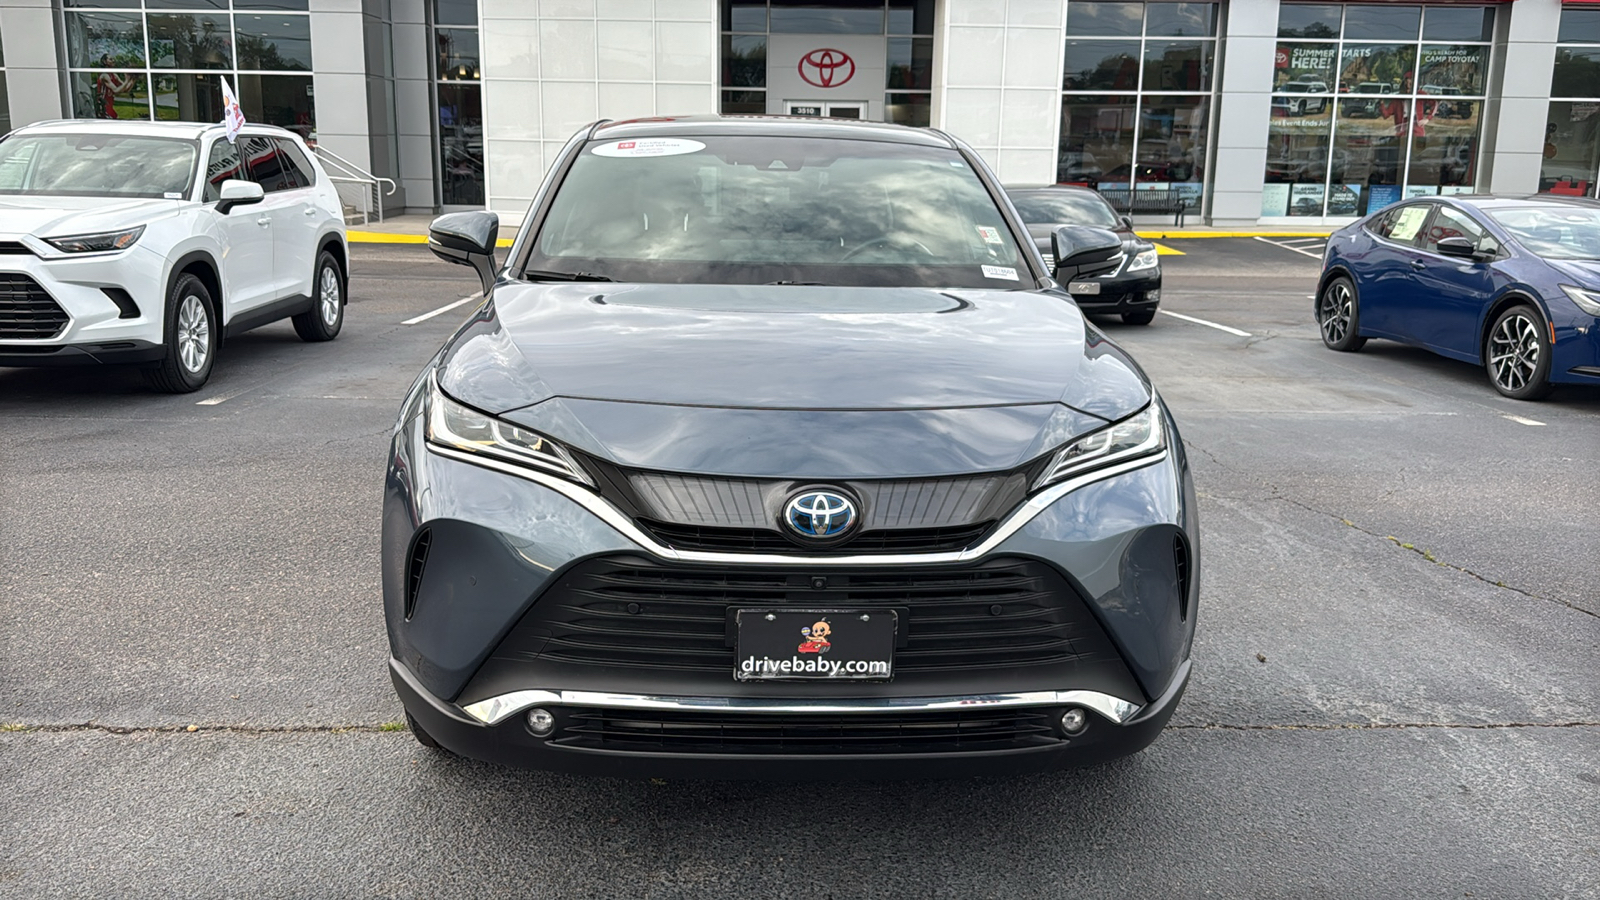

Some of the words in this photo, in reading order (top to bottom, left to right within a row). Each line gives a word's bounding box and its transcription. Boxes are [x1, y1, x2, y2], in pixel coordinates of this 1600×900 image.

[1292, 48, 1335, 58] SUMMER
[1341, 48, 1371, 57] TARTS
[1291, 57, 1332, 69] HERE!
[1448, 55, 1480, 63] TOYOTA?
[741, 655, 887, 676] drivebaby.com
